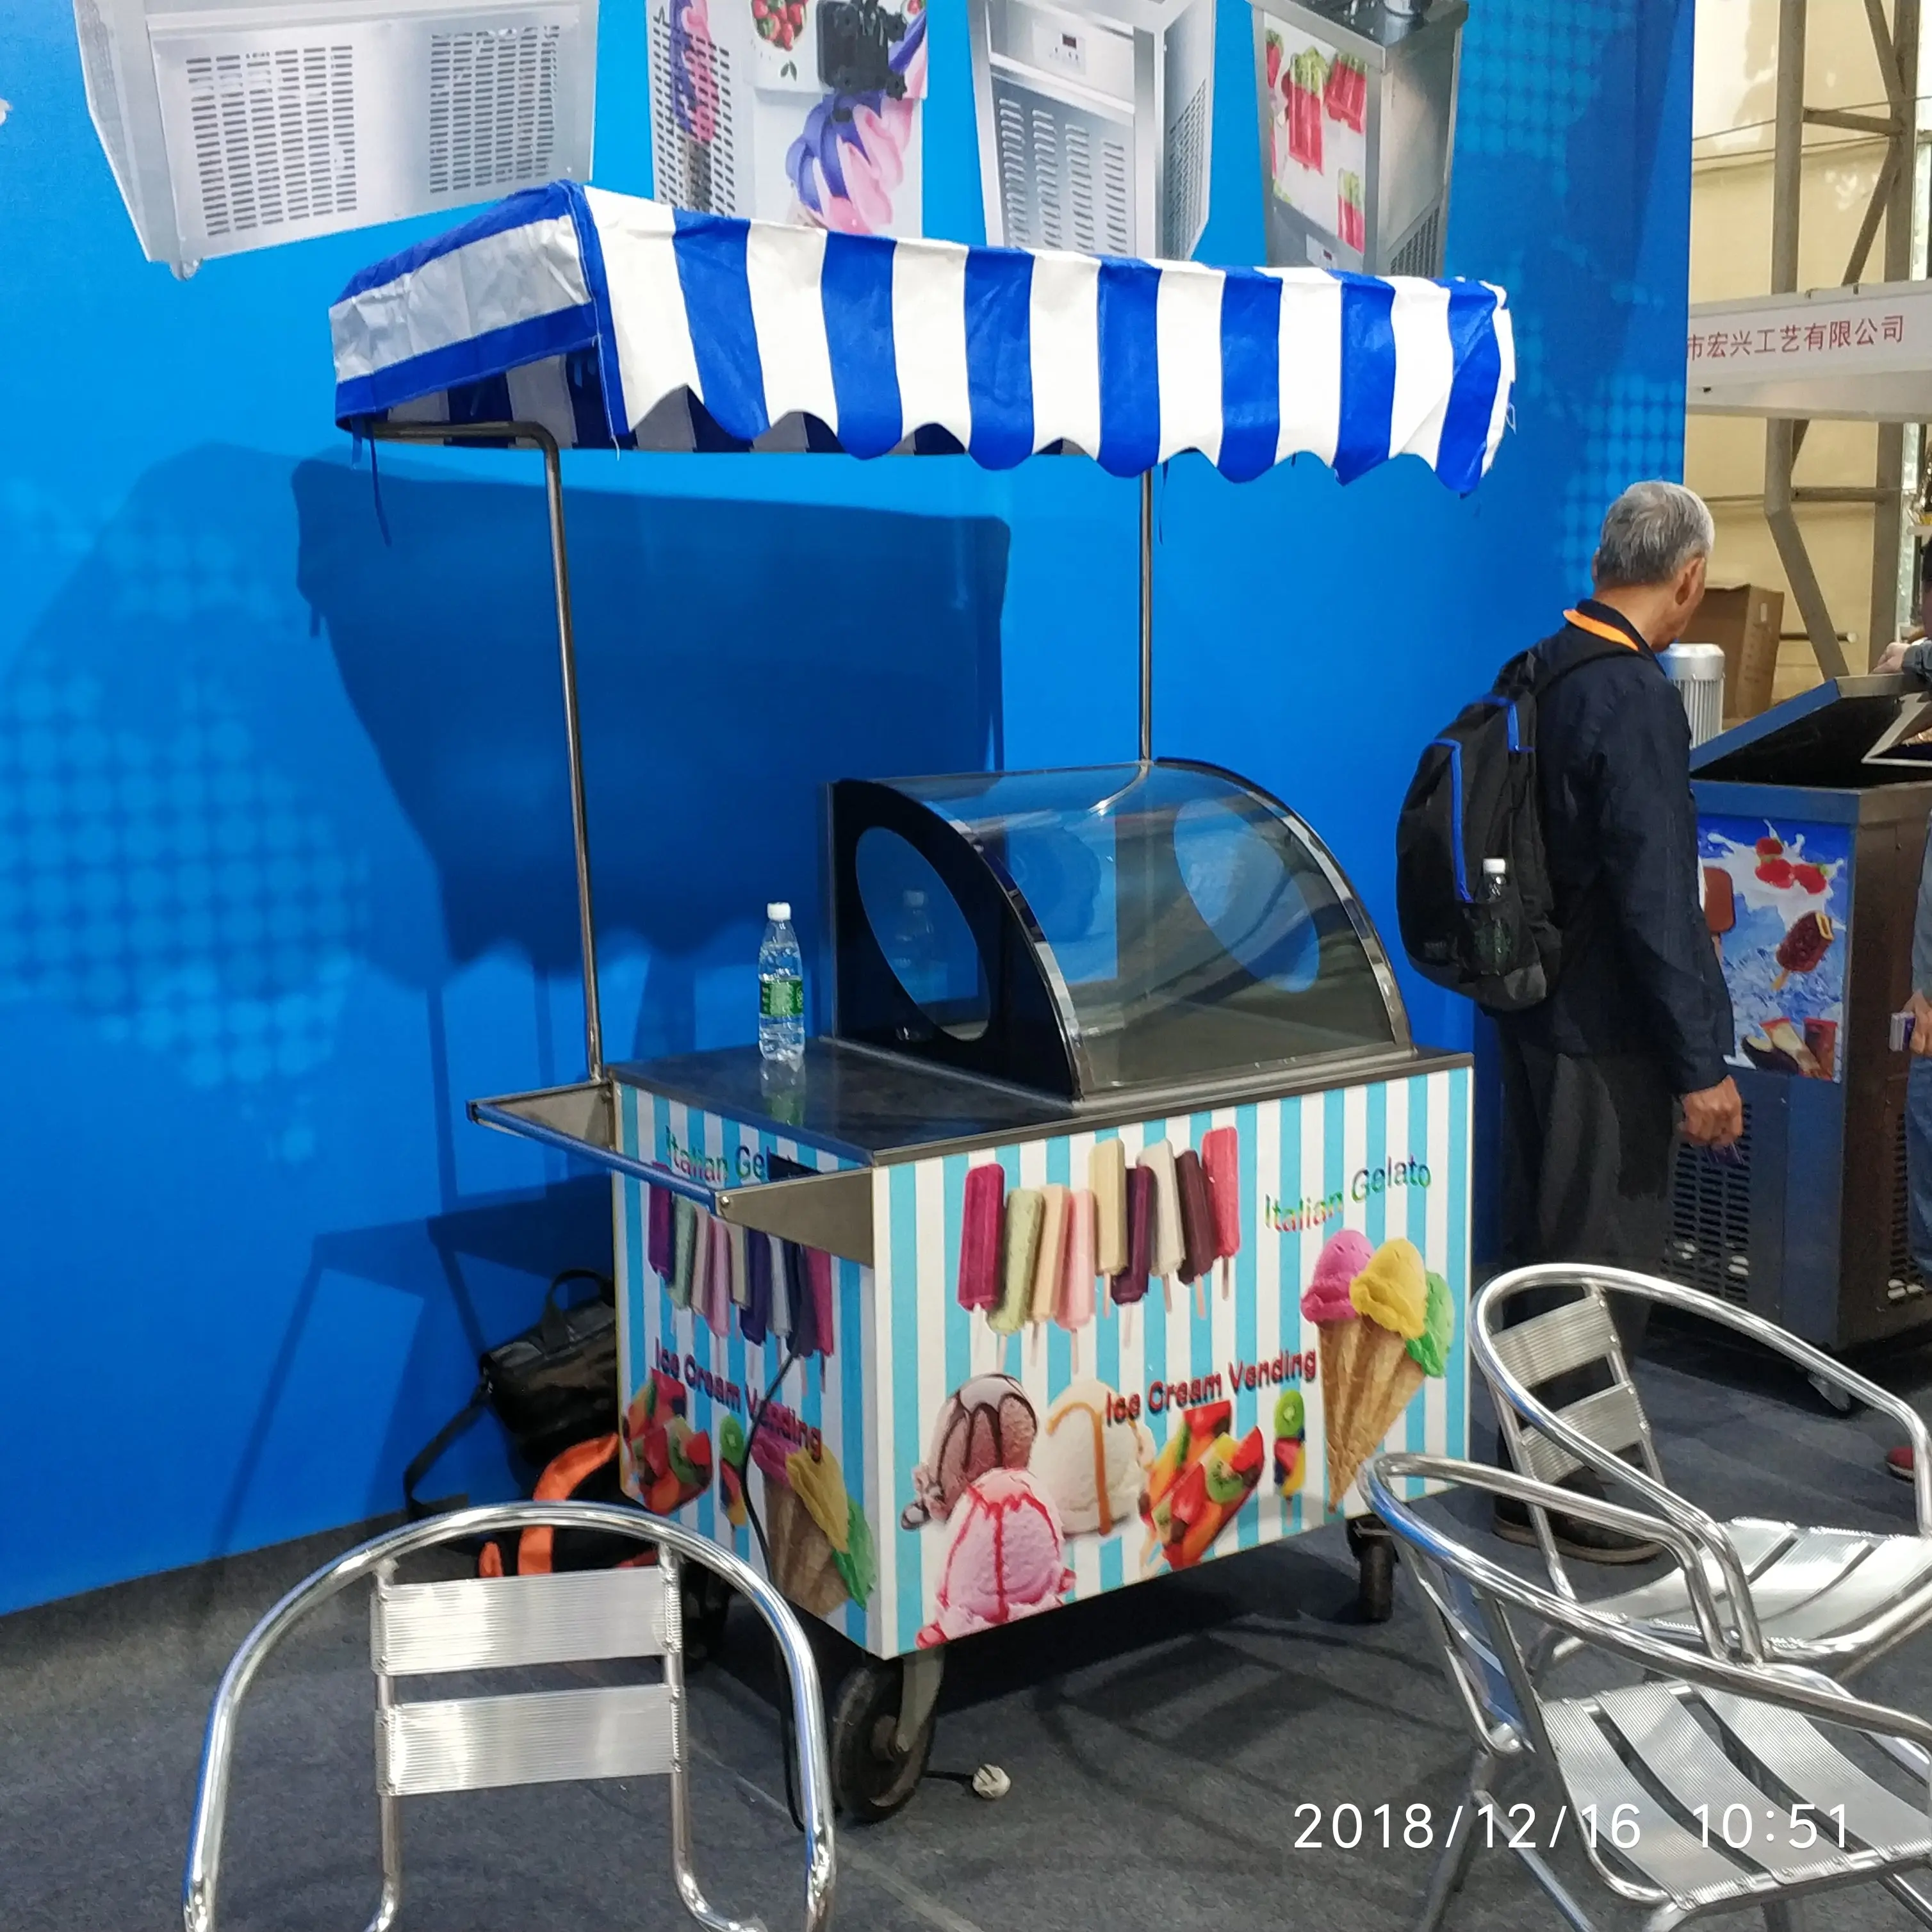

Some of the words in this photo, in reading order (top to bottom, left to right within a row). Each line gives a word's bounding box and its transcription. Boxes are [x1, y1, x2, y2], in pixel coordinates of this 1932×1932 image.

[1687, 315, 1904, 361] 市宏兴工艺有限公司
[666, 1125, 728, 1183] Italian
[1265, 1191, 1343, 1232] Italian
[1351, 1153, 1432, 1203] Gelato
[655, 1336, 680, 1379] Ice
[684, 1354, 741, 1414] Cream
[1106, 1391, 1141, 1427] Ice
[1148, 1371, 1223, 1415] Cream
[1228, 1348, 1317, 1395] Vending
